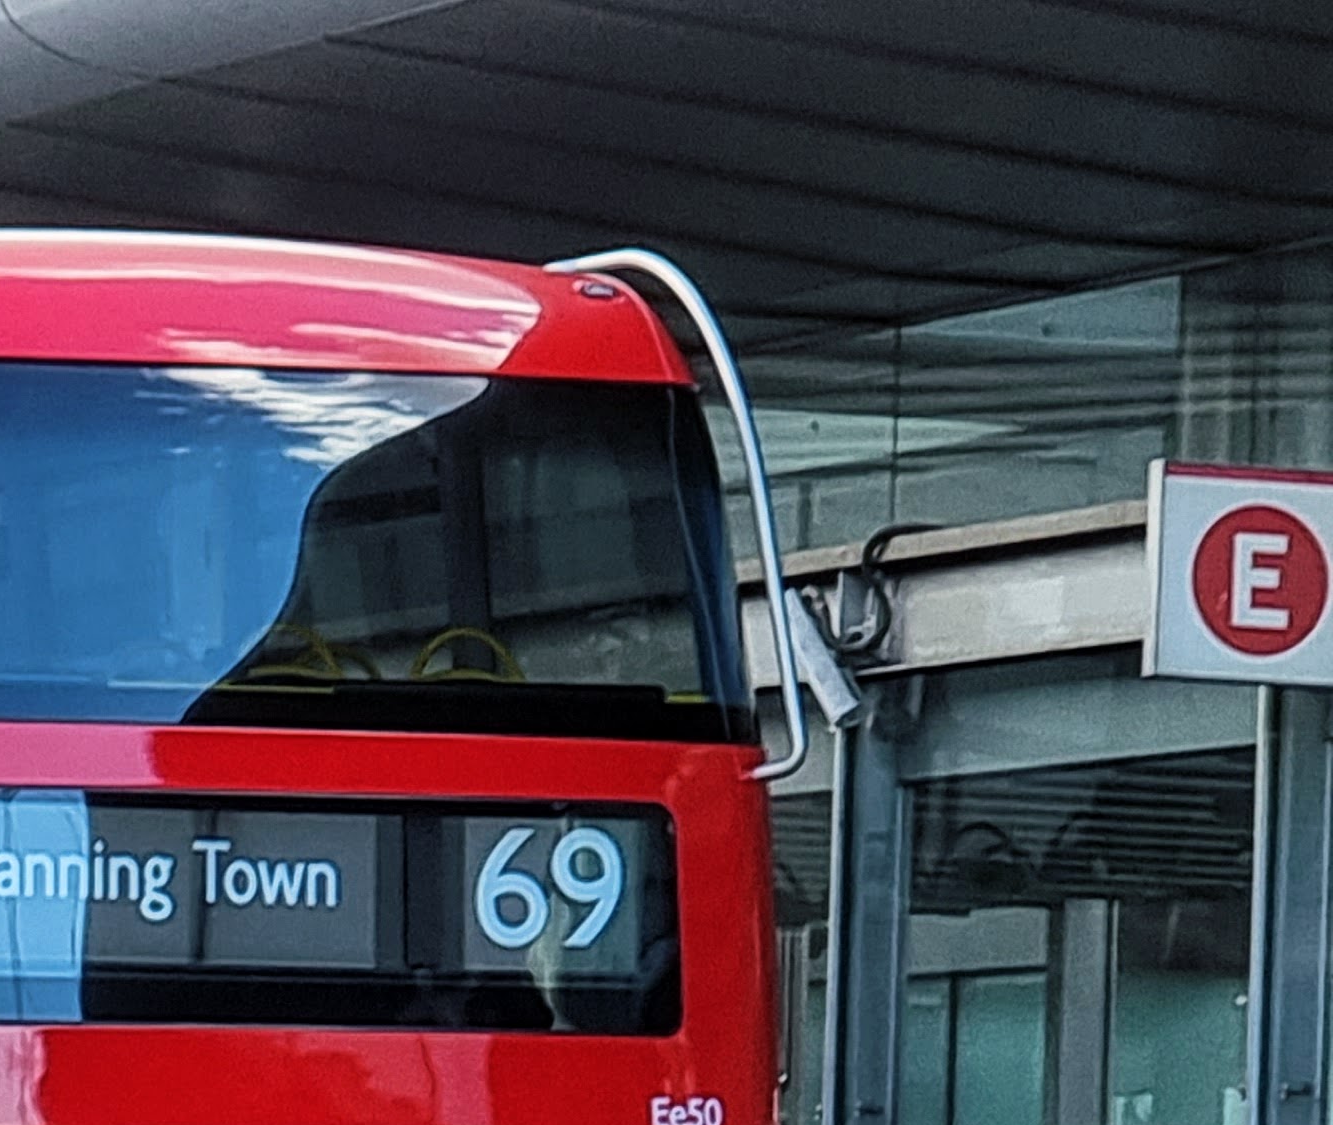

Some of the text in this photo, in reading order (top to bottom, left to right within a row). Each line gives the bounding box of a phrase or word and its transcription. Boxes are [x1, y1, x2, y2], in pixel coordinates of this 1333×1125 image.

[1231, 531, 1290, 630] E
[192, 838, 338, 909] Town
[475, 826, 625, 951] 69
